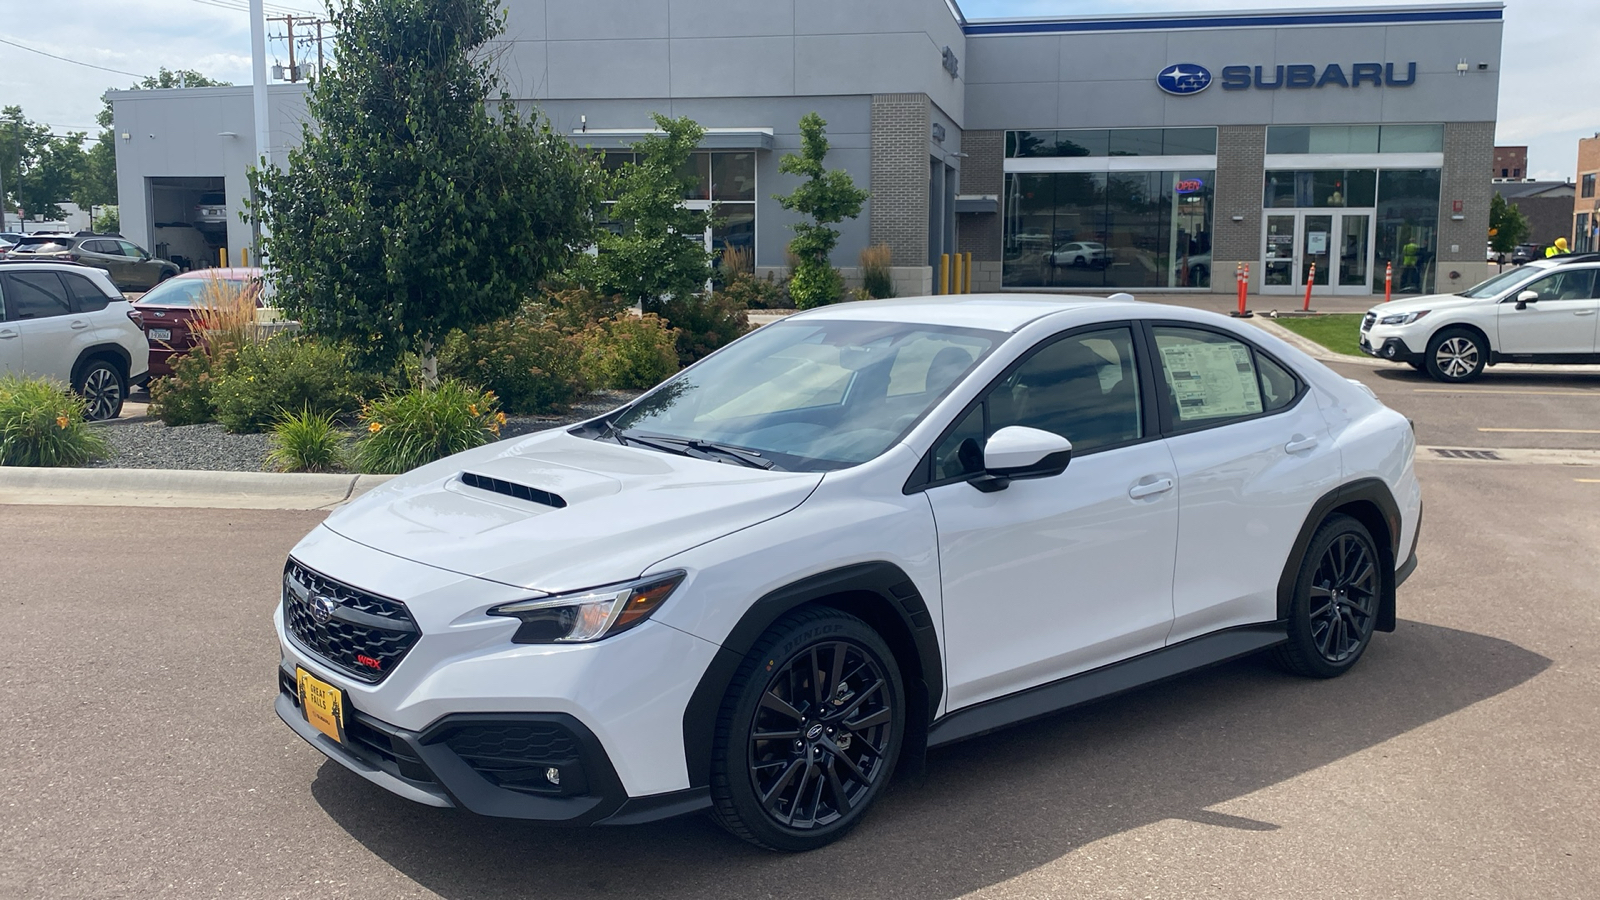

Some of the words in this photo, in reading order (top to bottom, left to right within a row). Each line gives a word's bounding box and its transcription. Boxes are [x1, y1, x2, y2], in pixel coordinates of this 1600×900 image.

[1221, 62, 1417, 90] SUBARU
[1176, 181, 1200, 190] OPEN
[784, 624, 844, 654] DUNLOP
[357, 654, 381, 670] WRX
[310, 684, 326, 699] GREAT
[311, 693, 327, 710] FALLS
